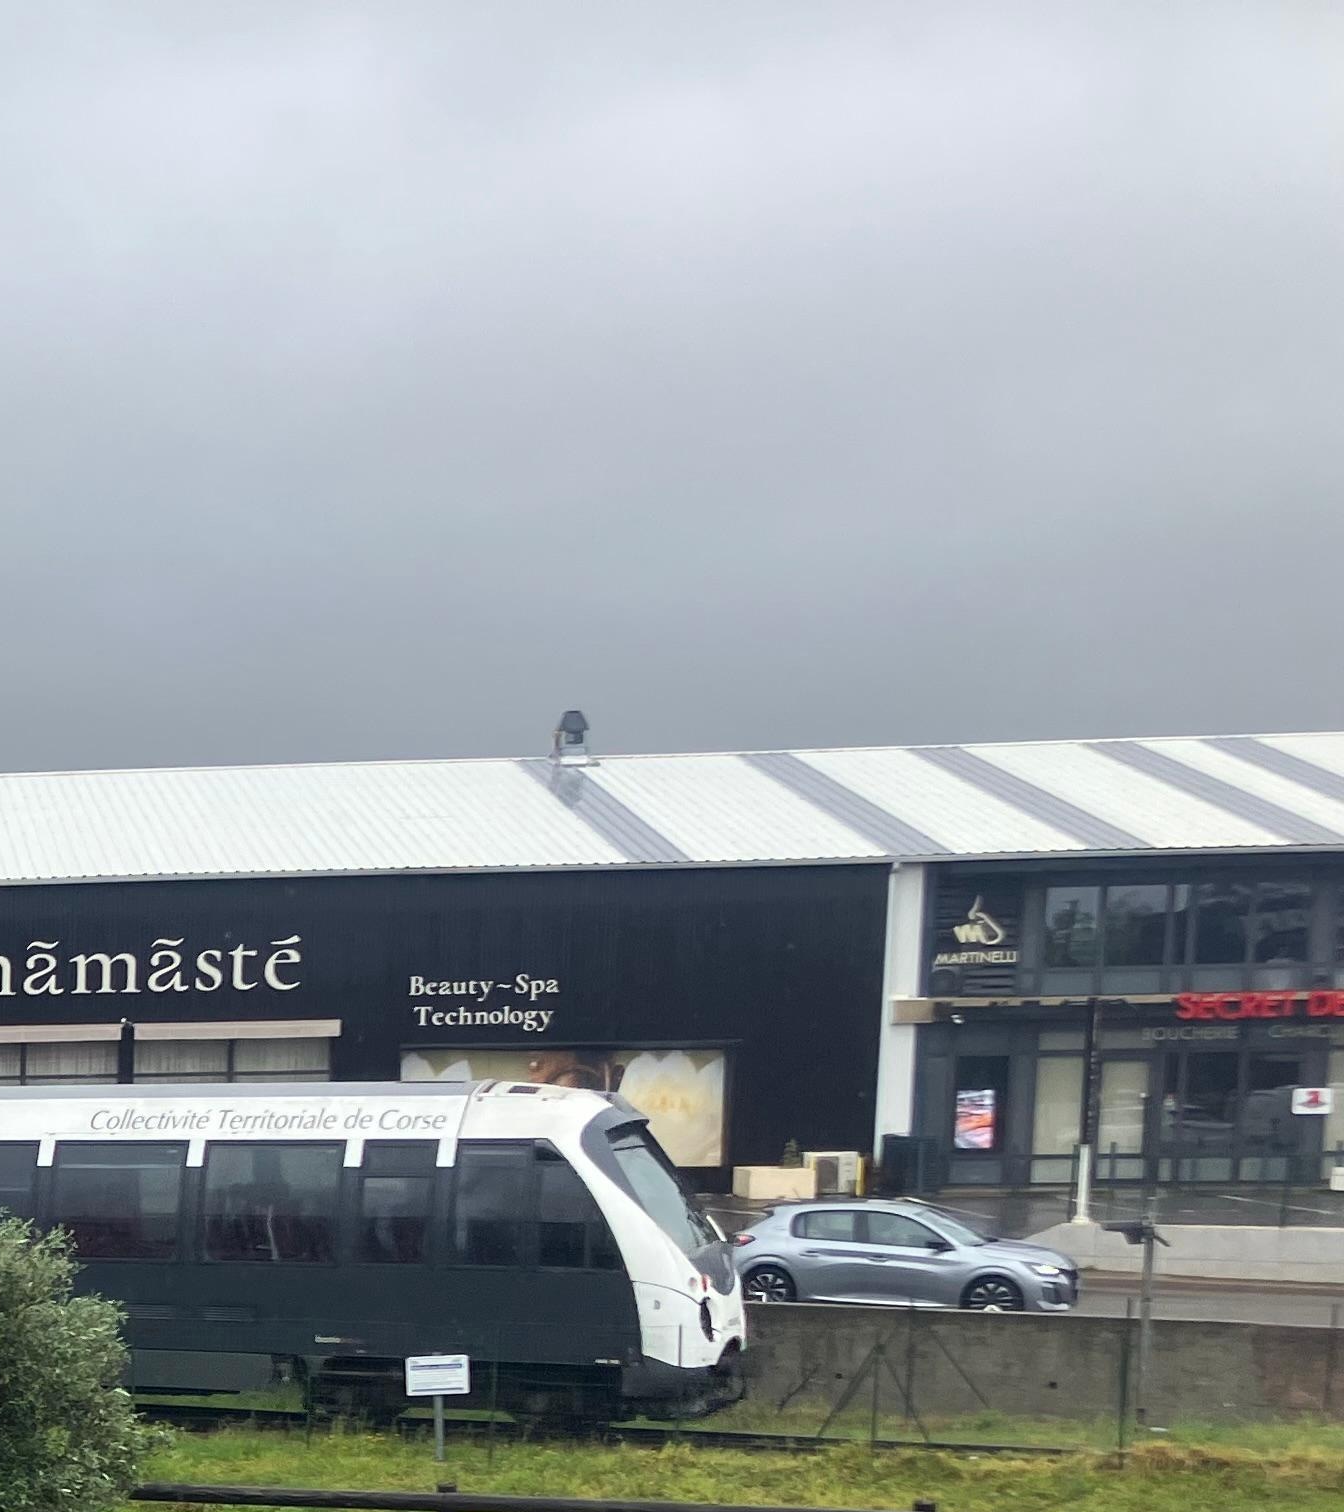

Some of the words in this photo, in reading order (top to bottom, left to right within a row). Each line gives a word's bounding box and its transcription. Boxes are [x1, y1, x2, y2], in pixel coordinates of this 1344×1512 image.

[934, 951, 1017, 966] MARTINELLI
[413, 1006, 554, 1032] Technology
[90, 1109, 211, 1130] Collectivité
[218, 1108, 337, 1130] Territoriale
[343, 1108, 373, 1130] de
[378, 1109, 447, 1130] Corse
